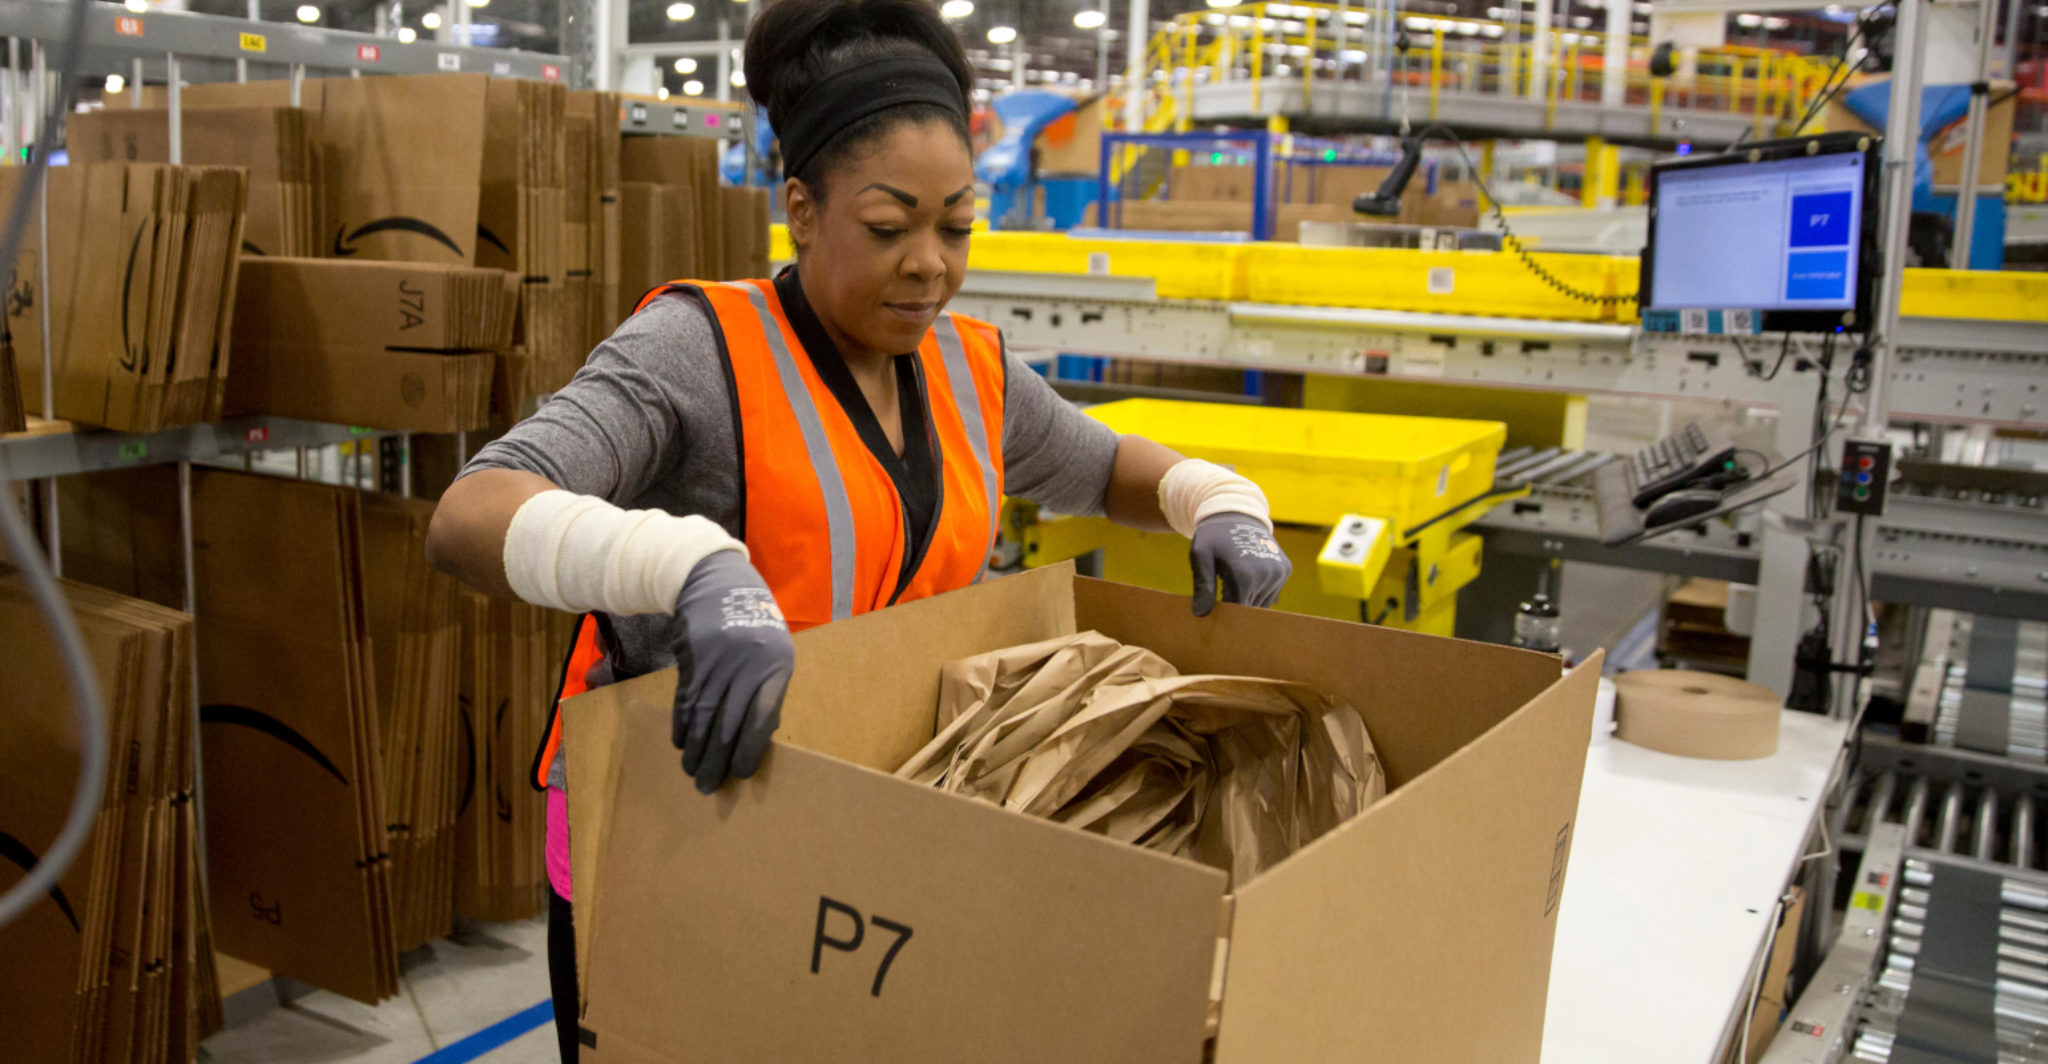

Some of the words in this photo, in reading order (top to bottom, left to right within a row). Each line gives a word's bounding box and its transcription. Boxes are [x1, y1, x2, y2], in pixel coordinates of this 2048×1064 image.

[1810, 213, 1830, 227] P7
[399, 280, 424, 331] J7A
[249, 892, 282, 927] P5
[811, 895, 913, 998] P7
